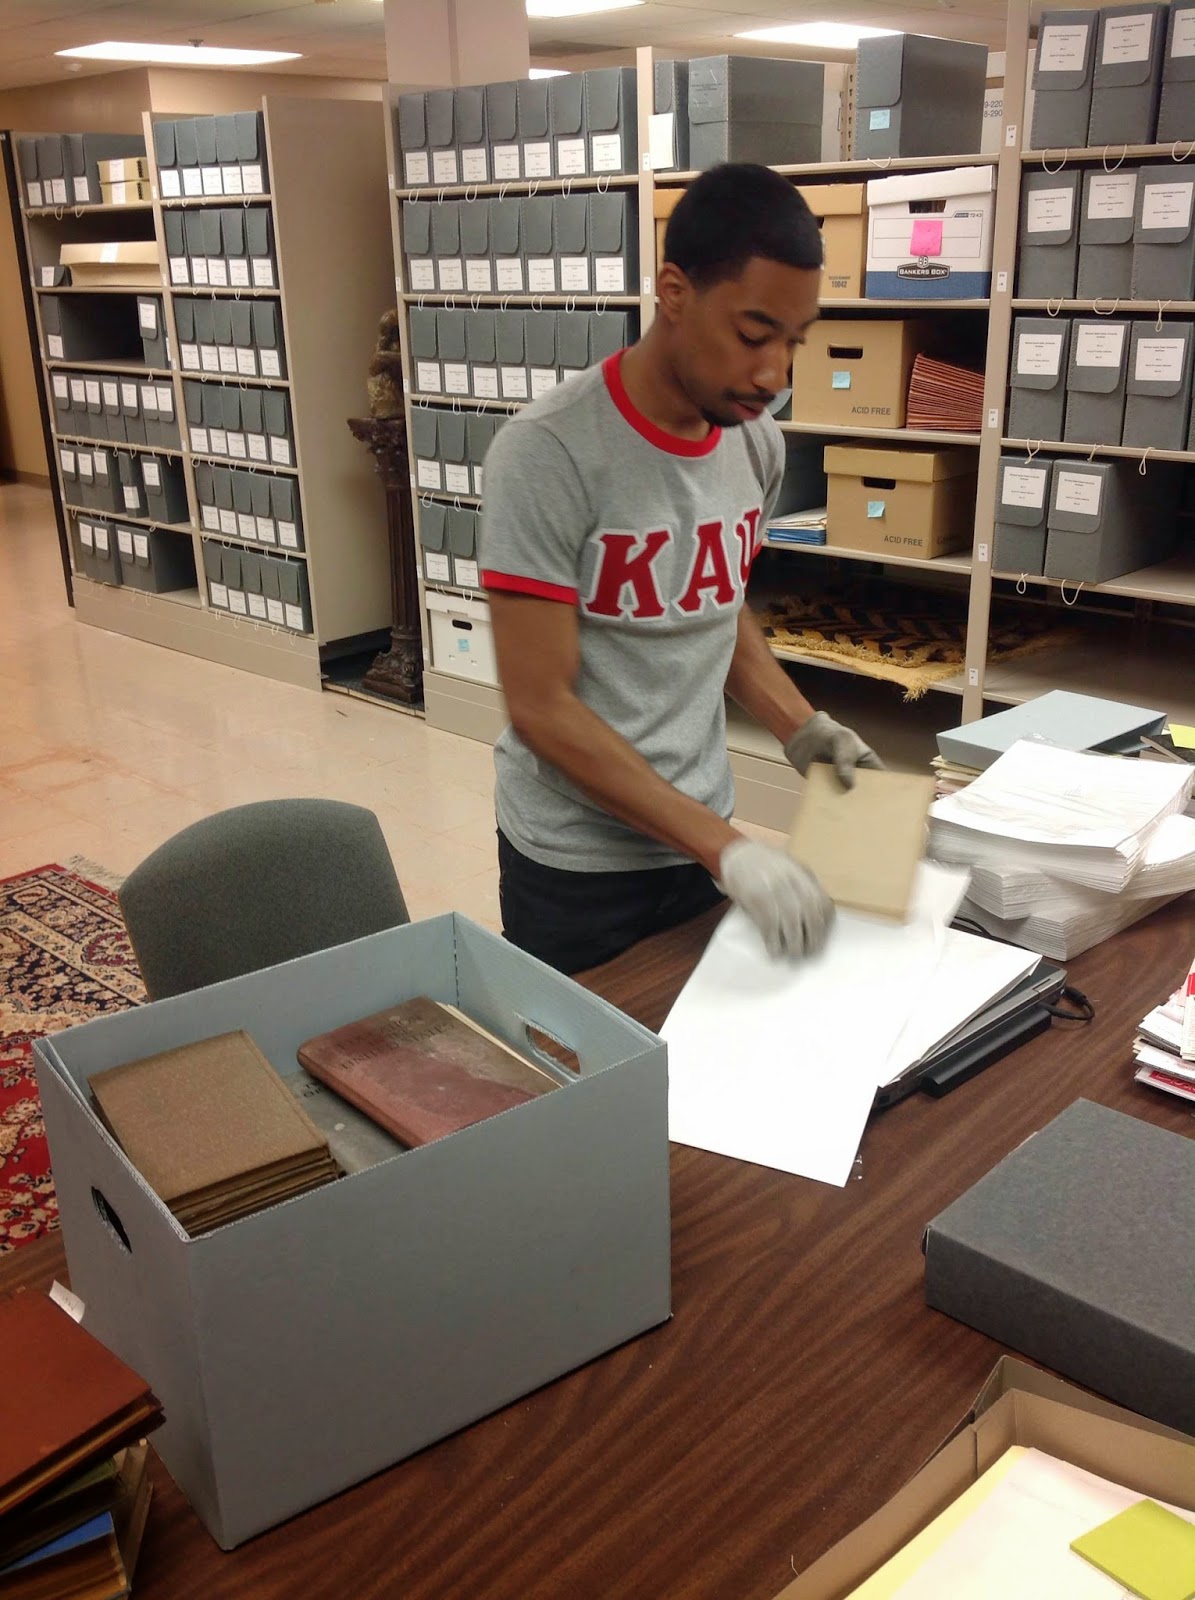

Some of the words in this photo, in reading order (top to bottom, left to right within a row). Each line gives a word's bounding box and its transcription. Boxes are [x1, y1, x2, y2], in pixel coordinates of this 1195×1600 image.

[851, 406, 870, 414] ACID
[871, 407, 891, 416] FREE
[884, 535, 902, 544] ACID
[903, 538, 923, 547] FREE
